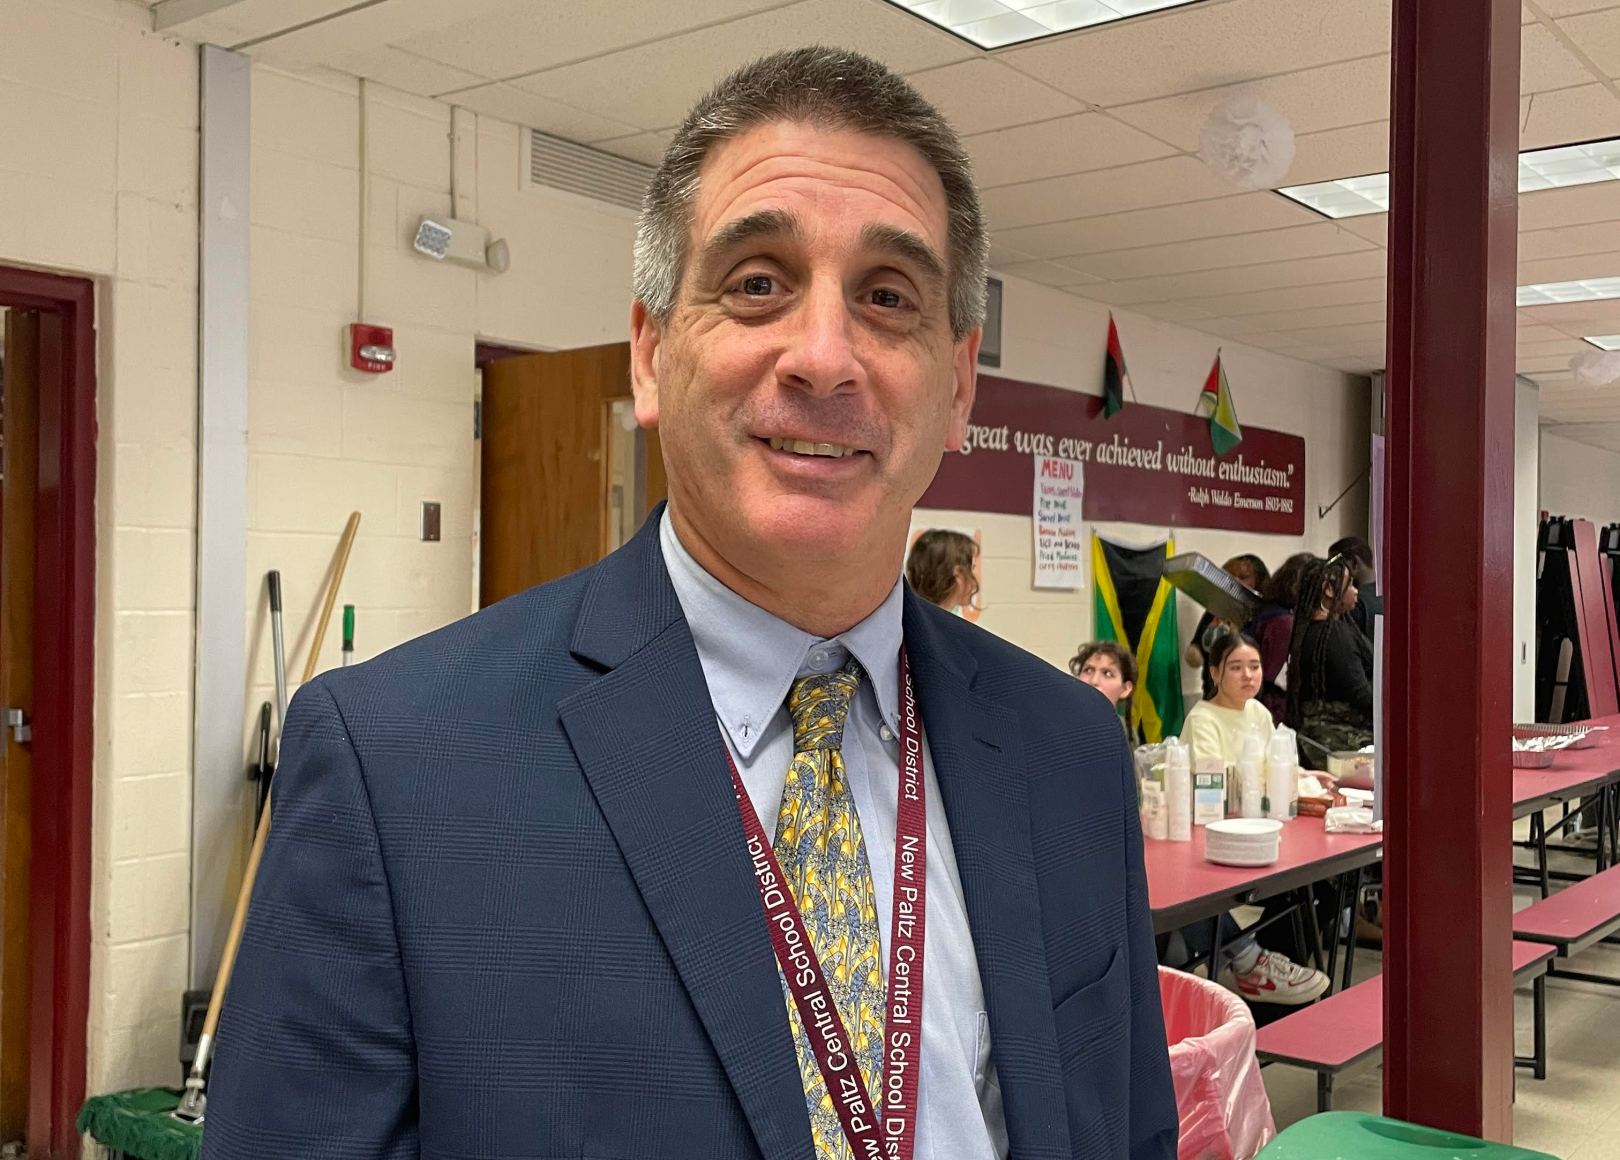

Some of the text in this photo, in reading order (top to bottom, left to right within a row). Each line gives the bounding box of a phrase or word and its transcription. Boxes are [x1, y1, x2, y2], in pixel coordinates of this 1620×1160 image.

[959, 424, 1009, 455] great
[1014, 430, 1054, 455] was
[1058, 437, 1092, 461] ever
[1096, 434, 1162, 470] achieved
[1166, 445, 1215, 478] without
[1041, 458, 1073, 480] MENU
[1211, 489, 1232, 508] Waldo
[1234, 492, 1263, 510] Emerson
[905, 673, 918, 734] School
[905, 737, 919, 801] District
[747, 834, 872, 1134] Paltz Central School District
[886, 835, 919, 1160] New Paltz Central School Dist
